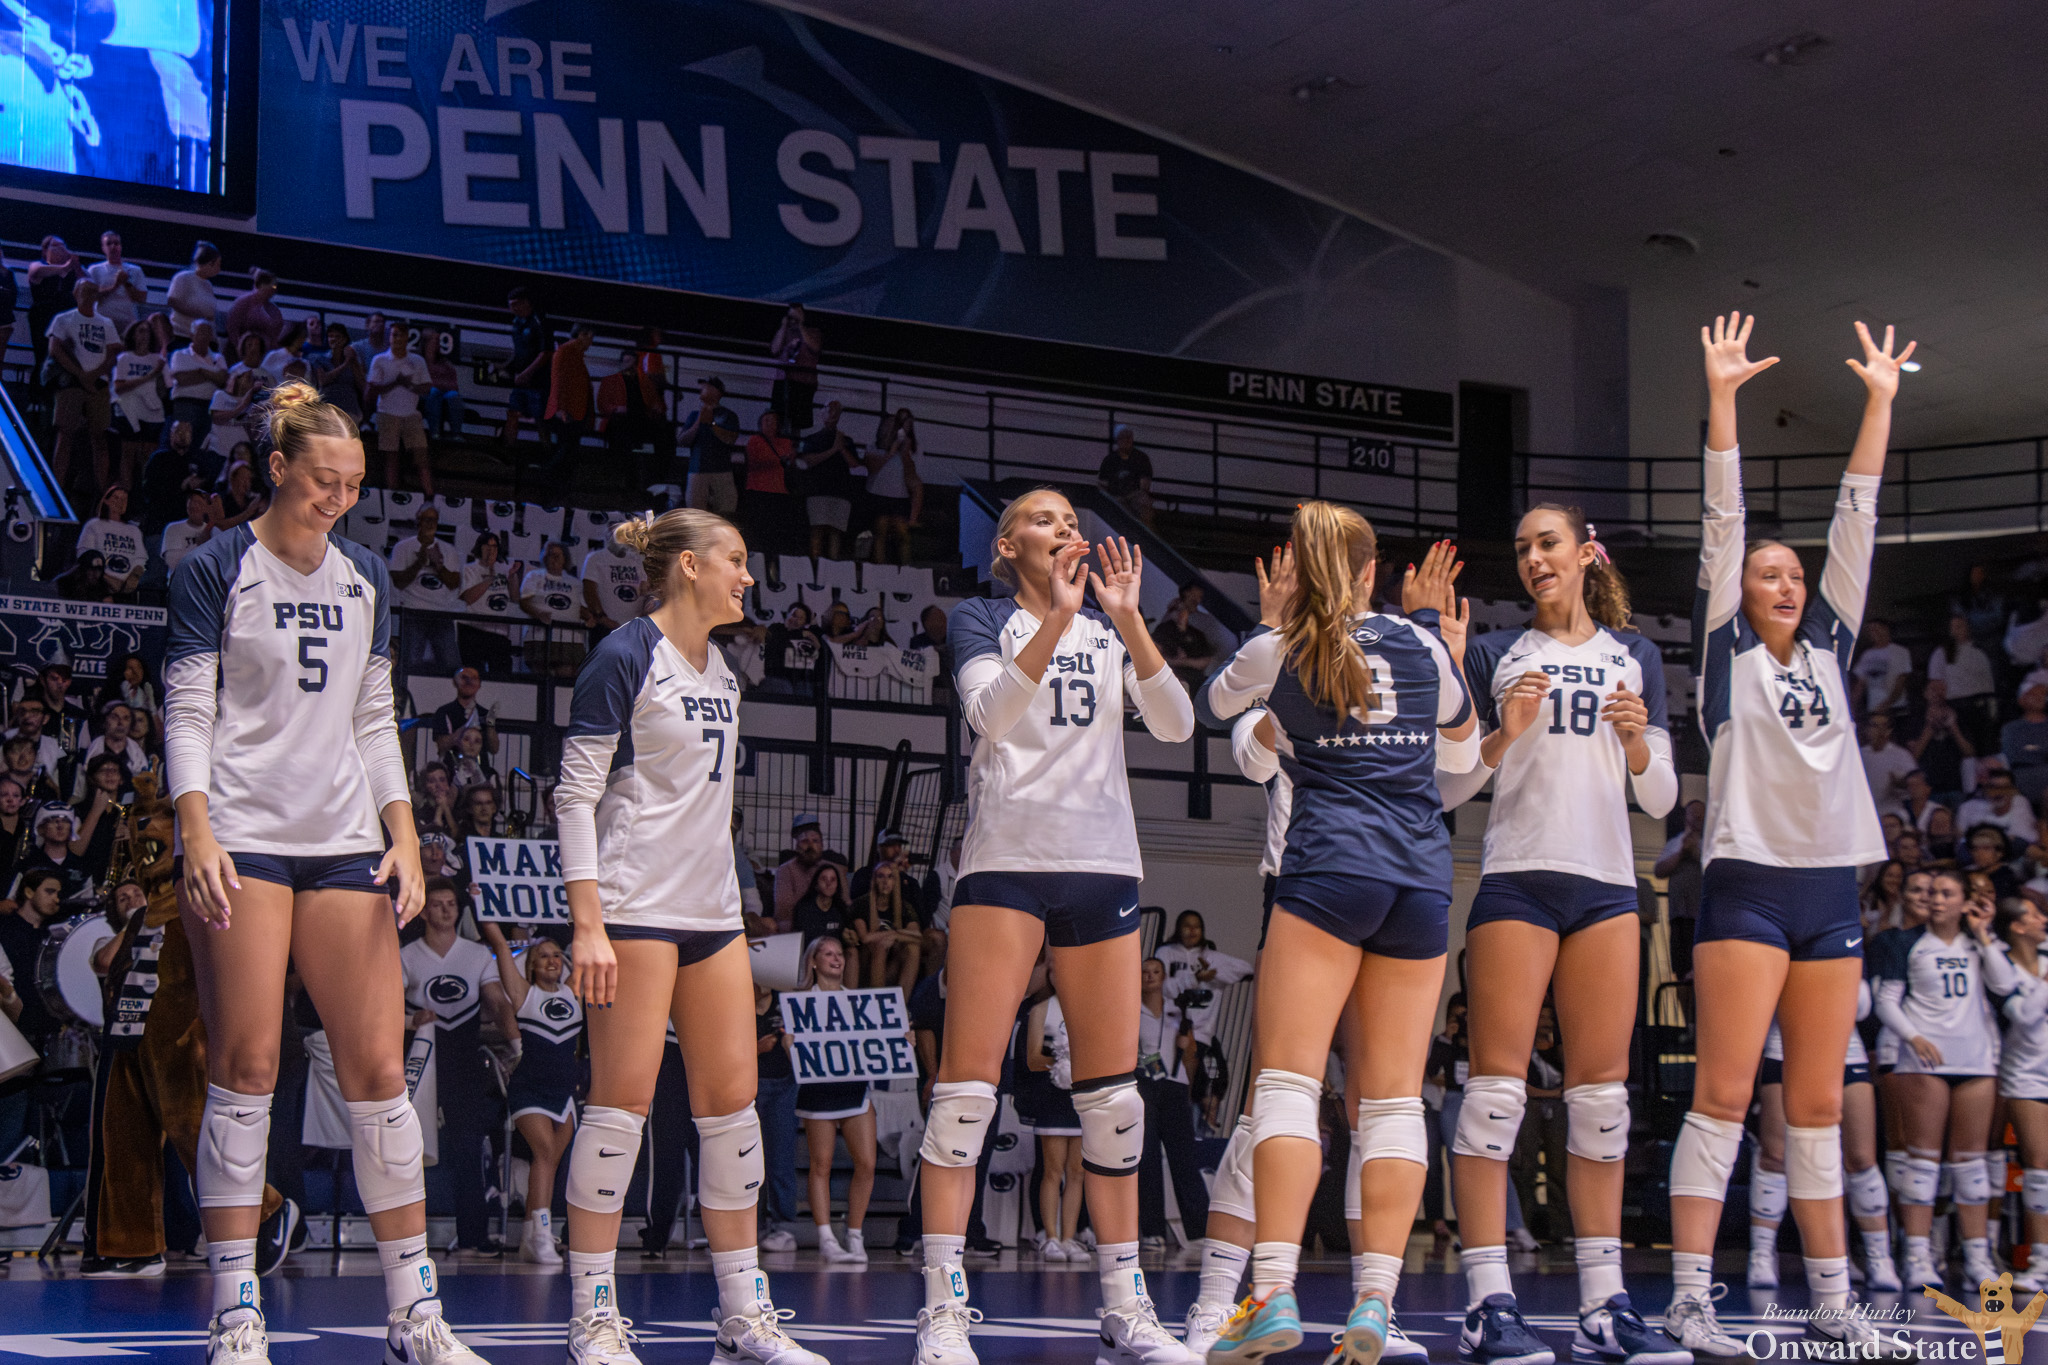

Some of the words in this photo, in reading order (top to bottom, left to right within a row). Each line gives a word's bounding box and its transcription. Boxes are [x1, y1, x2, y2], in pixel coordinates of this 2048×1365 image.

[282, 17, 412, 89] WE
[440, 32, 597, 103] ARE
[340, 99, 732, 240] PENN
[776, 129, 1168, 261] STATE
[406, 328, 454, 355] 29
[1228, 371, 1306, 404] PENN
[1315, 381, 1404, 416] STATE
[1353, 446, 1390, 469] 210
[13, 599, 61, 614] STATE
[65, 603, 88, 616] WE
[91, 605, 122, 619] ARE
[125, 608, 165, 622] PENN
[273, 602, 344, 632] PSU
[73, 659, 108, 674] TATE
[298, 636, 328, 693] 5
[1046, 652, 1096, 675] SU
[1541, 664, 1606, 687] PSU
[1049, 677, 1097, 728] 13
[1350, 654, 1398, 725] 3
[1779, 684, 1831, 729] 44
[680, 696, 733, 724] PSU
[1548, 688, 1599, 737] 18
[702, 728, 725, 782] 7
[474, 842, 563, 878] MAK
[478, 883, 570, 919] NOIS
[1935, 957, 1969, 970] PSU
[1943, 972, 1968, 998] 10
[120, 999, 144, 1010] PENN
[787, 992, 903, 1034] MAKE
[793, 1037, 914, 1078] NOISE
